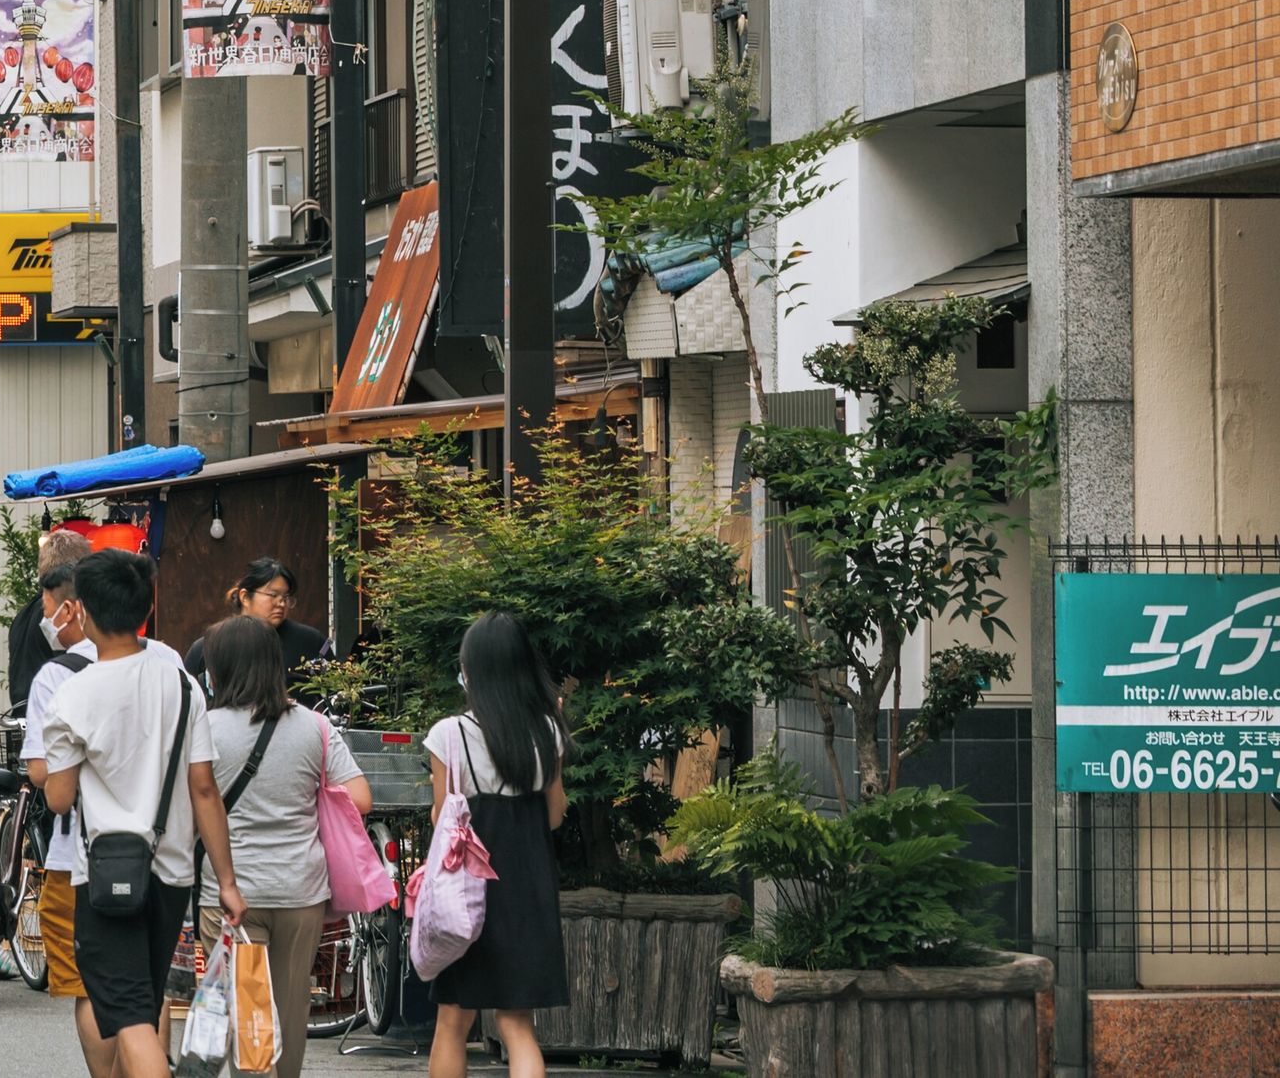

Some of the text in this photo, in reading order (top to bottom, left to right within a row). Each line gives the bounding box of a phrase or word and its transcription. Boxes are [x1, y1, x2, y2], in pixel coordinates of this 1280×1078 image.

[190, 45, 330, 67] 新世界春日通商店会
[1168, 709, 1274, 722] 株式会社エイブル
[1145, 731, 1225, 746] お問い合わせ
[1082, 762, 1109, 776] TEL
